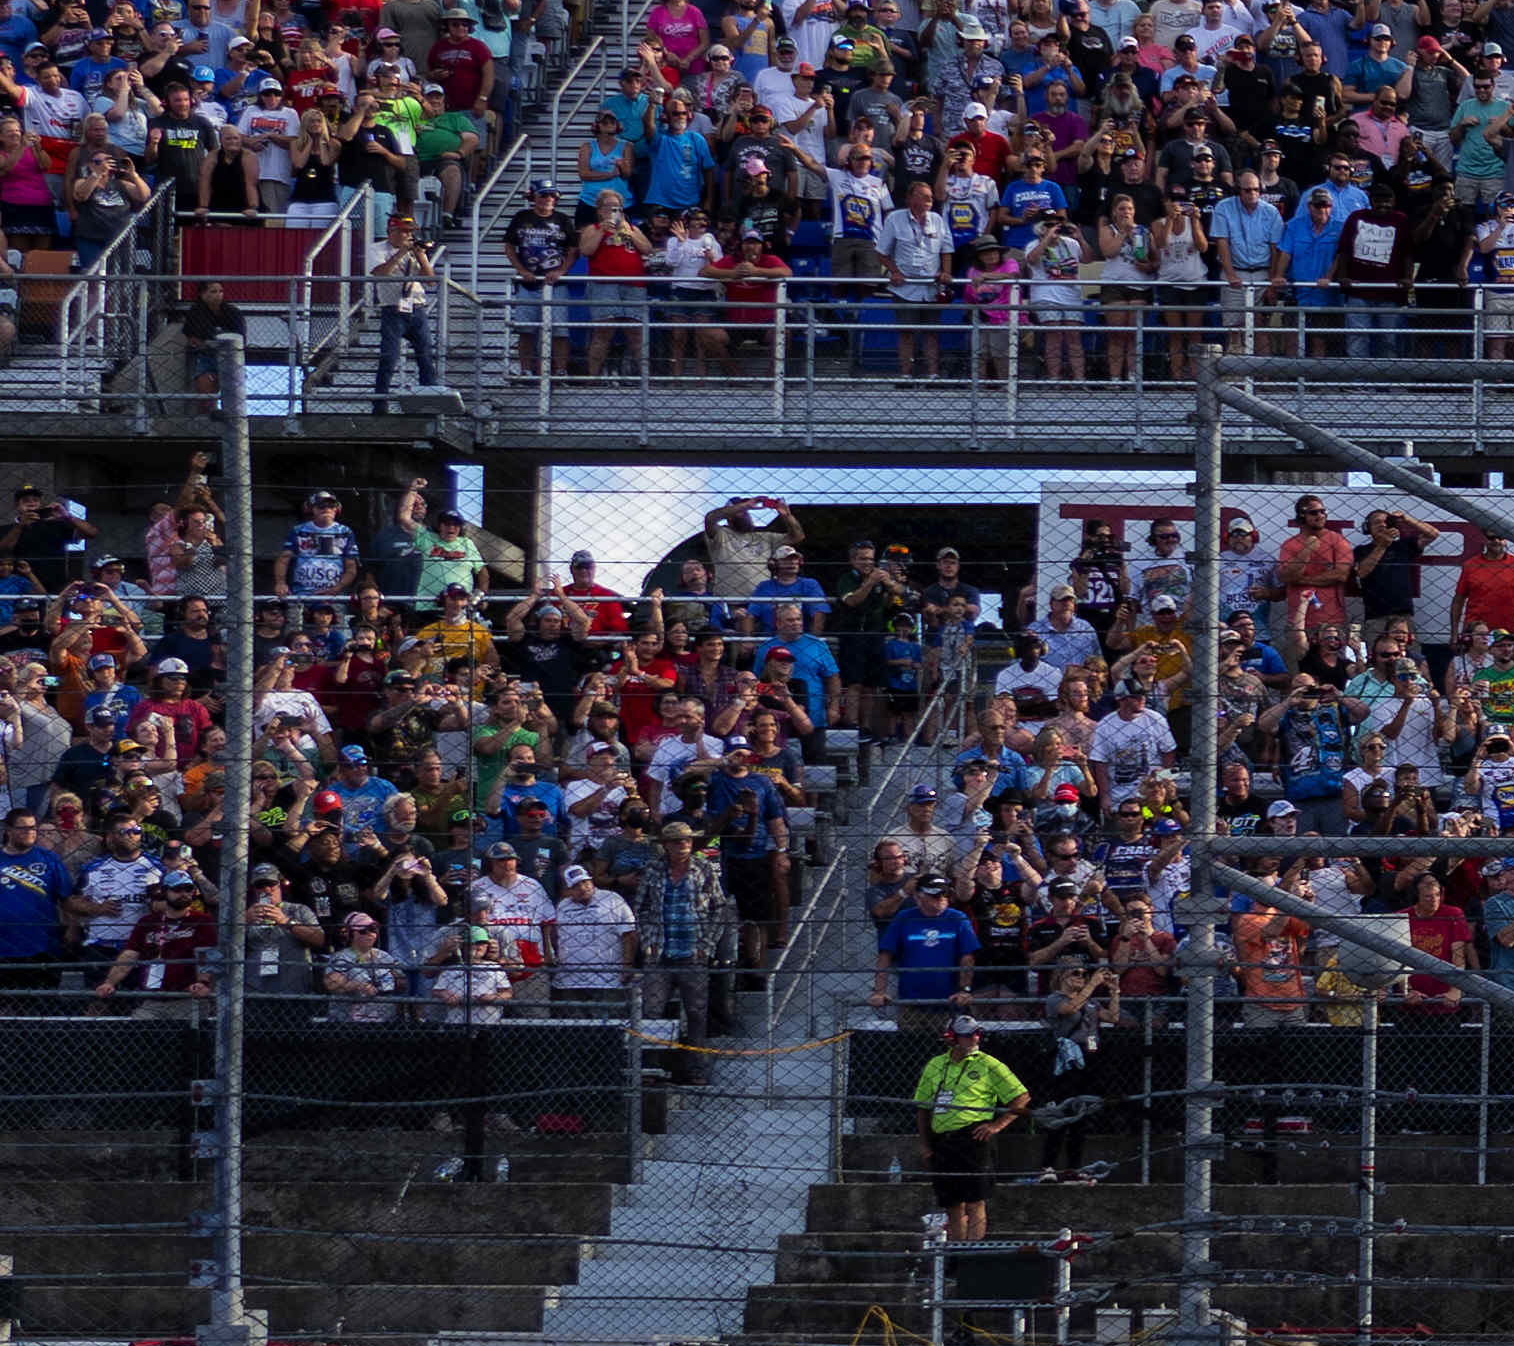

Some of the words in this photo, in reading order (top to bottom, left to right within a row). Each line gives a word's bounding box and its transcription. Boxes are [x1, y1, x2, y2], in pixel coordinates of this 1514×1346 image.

[297, 565, 340, 580] BUSCH
[1226, 593, 1257, 604] BUSC
[1290, 746, 1313, 774] 4
